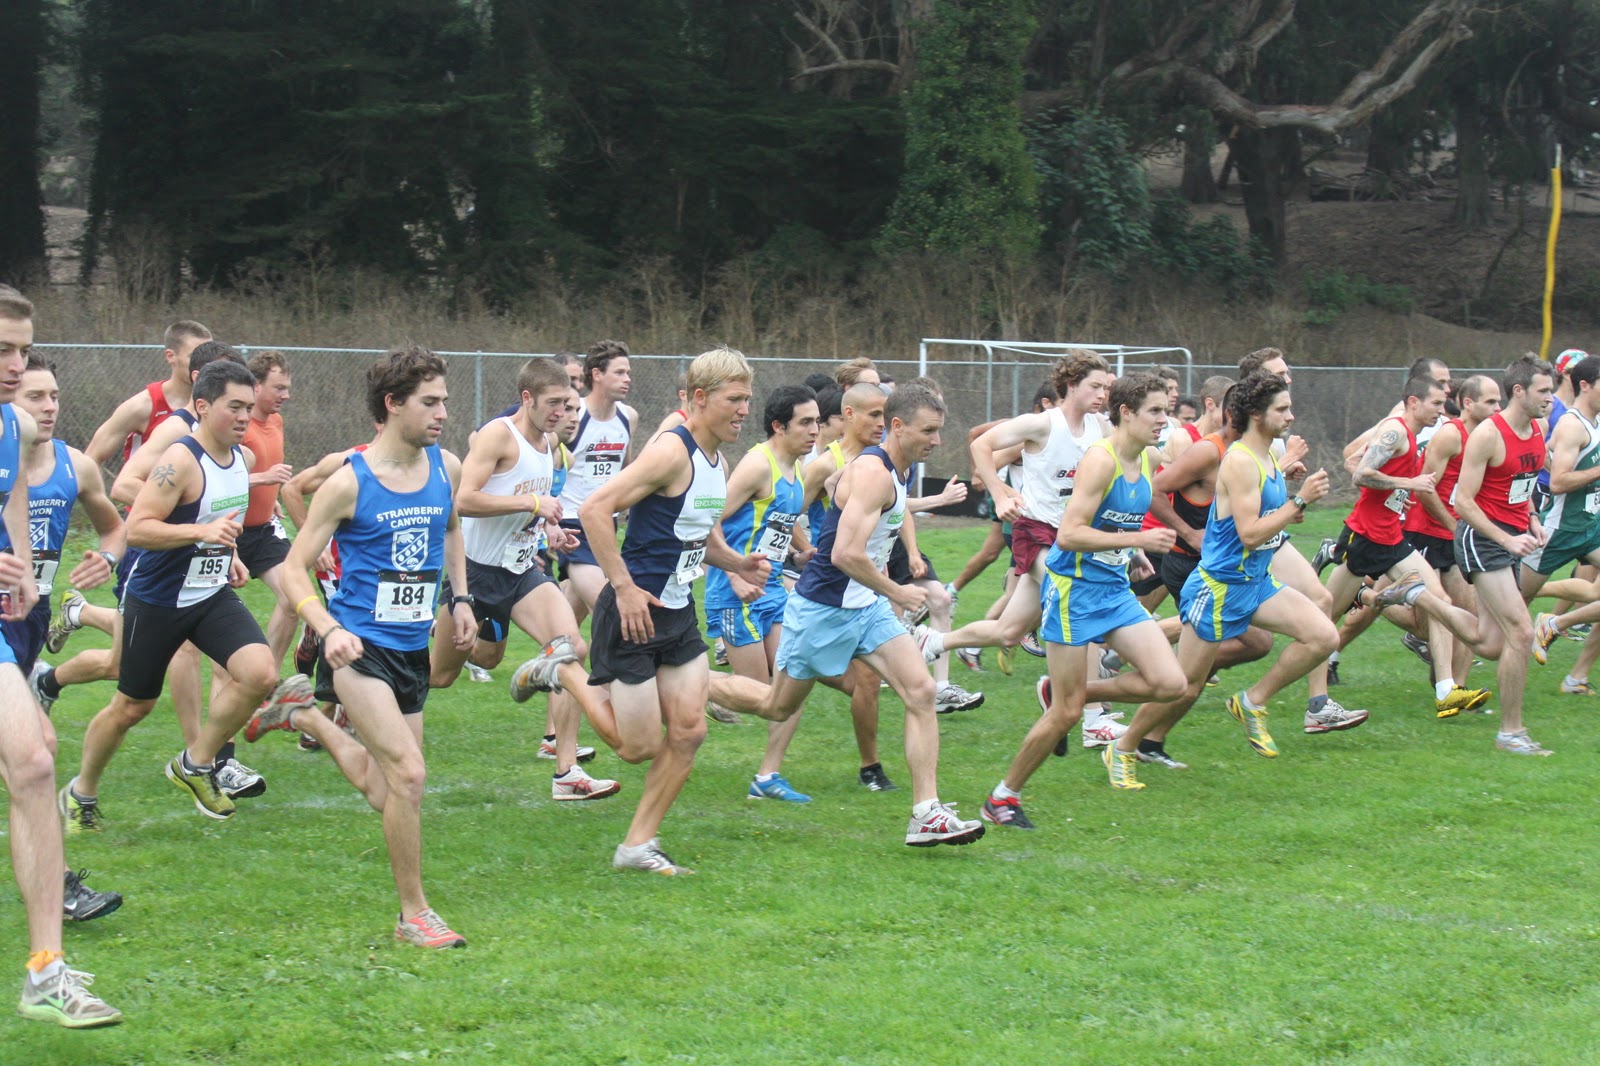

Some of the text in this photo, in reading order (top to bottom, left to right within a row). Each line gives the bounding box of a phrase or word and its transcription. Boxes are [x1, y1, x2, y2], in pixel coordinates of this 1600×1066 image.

[593, 463, 611, 475] 192
[1524, 480, 1530, 492] 1
[376, 506, 444, 522] STRAWBERRY
[390, 516, 431, 528] CANYON
[198, 559, 223, 575] 195
[391, 586, 425, 605] 184
